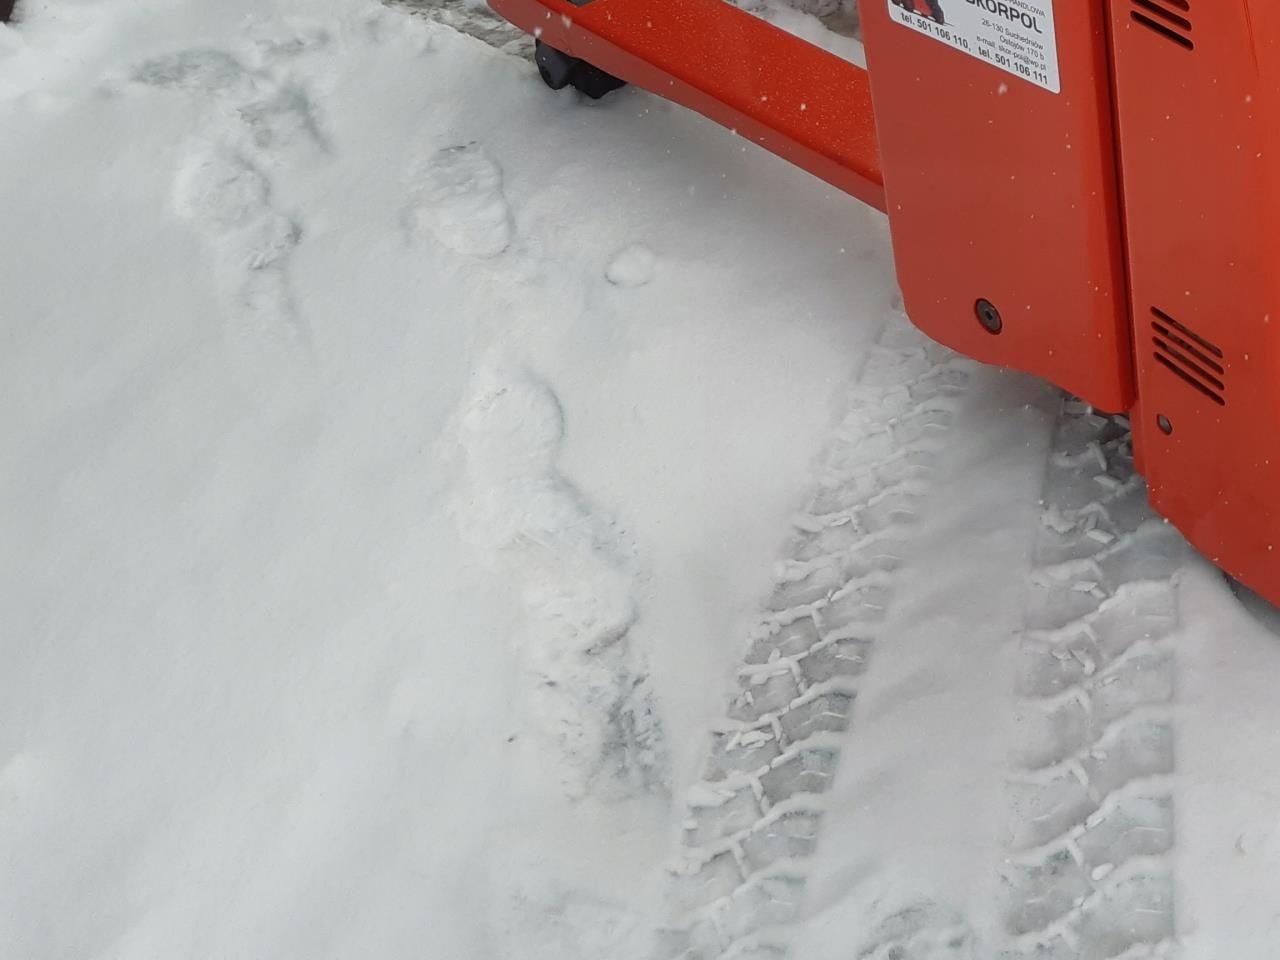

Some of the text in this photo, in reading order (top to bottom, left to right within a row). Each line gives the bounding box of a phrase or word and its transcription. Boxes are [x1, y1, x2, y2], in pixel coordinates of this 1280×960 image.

[901, 12, 915, 25] tel.
[917, 18, 931, 32] 501
[935, 26, 951, 41] 106
[978, 46, 993, 60] tel.
[995, 53, 1010, 68] 501
[1013, 62, 1031, 76] 106
[1033, 70, 1048, 85] 111
[1027, 47, 1039, 58] 170
